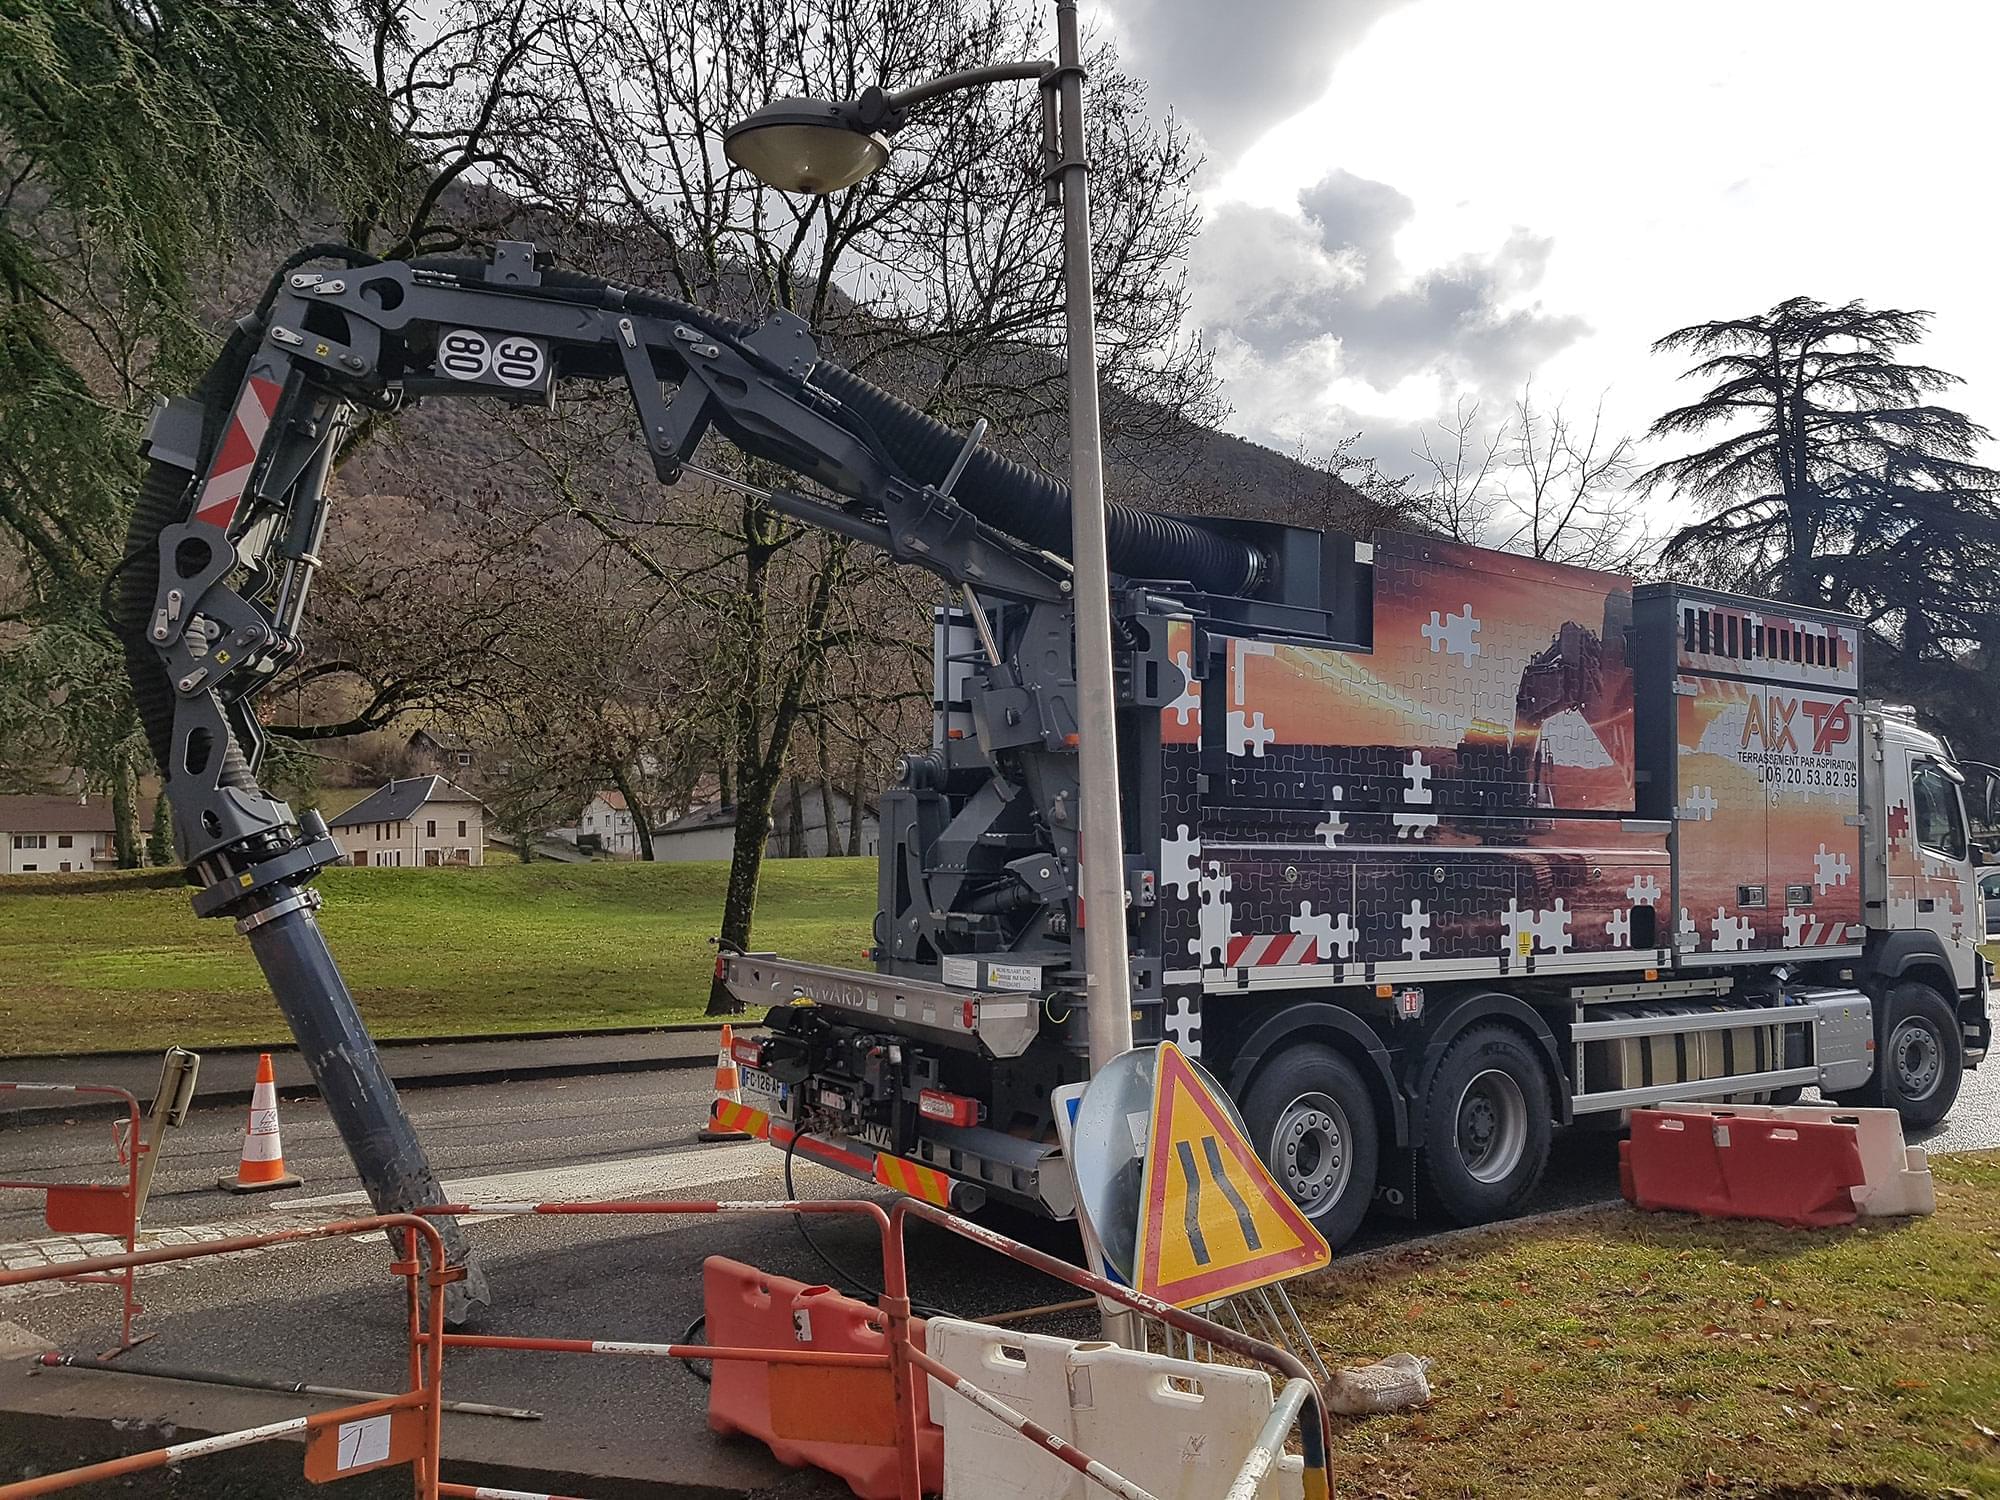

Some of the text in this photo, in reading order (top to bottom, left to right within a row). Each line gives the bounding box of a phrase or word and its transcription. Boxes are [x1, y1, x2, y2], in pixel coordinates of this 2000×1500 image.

[1741, 694, 1852, 755] AIX TP
[1737, 751, 1857, 771] TERRASSEMENT PAR ASPIRATION
[1766, 766, 1857, 788] 06.20.53.82.95
